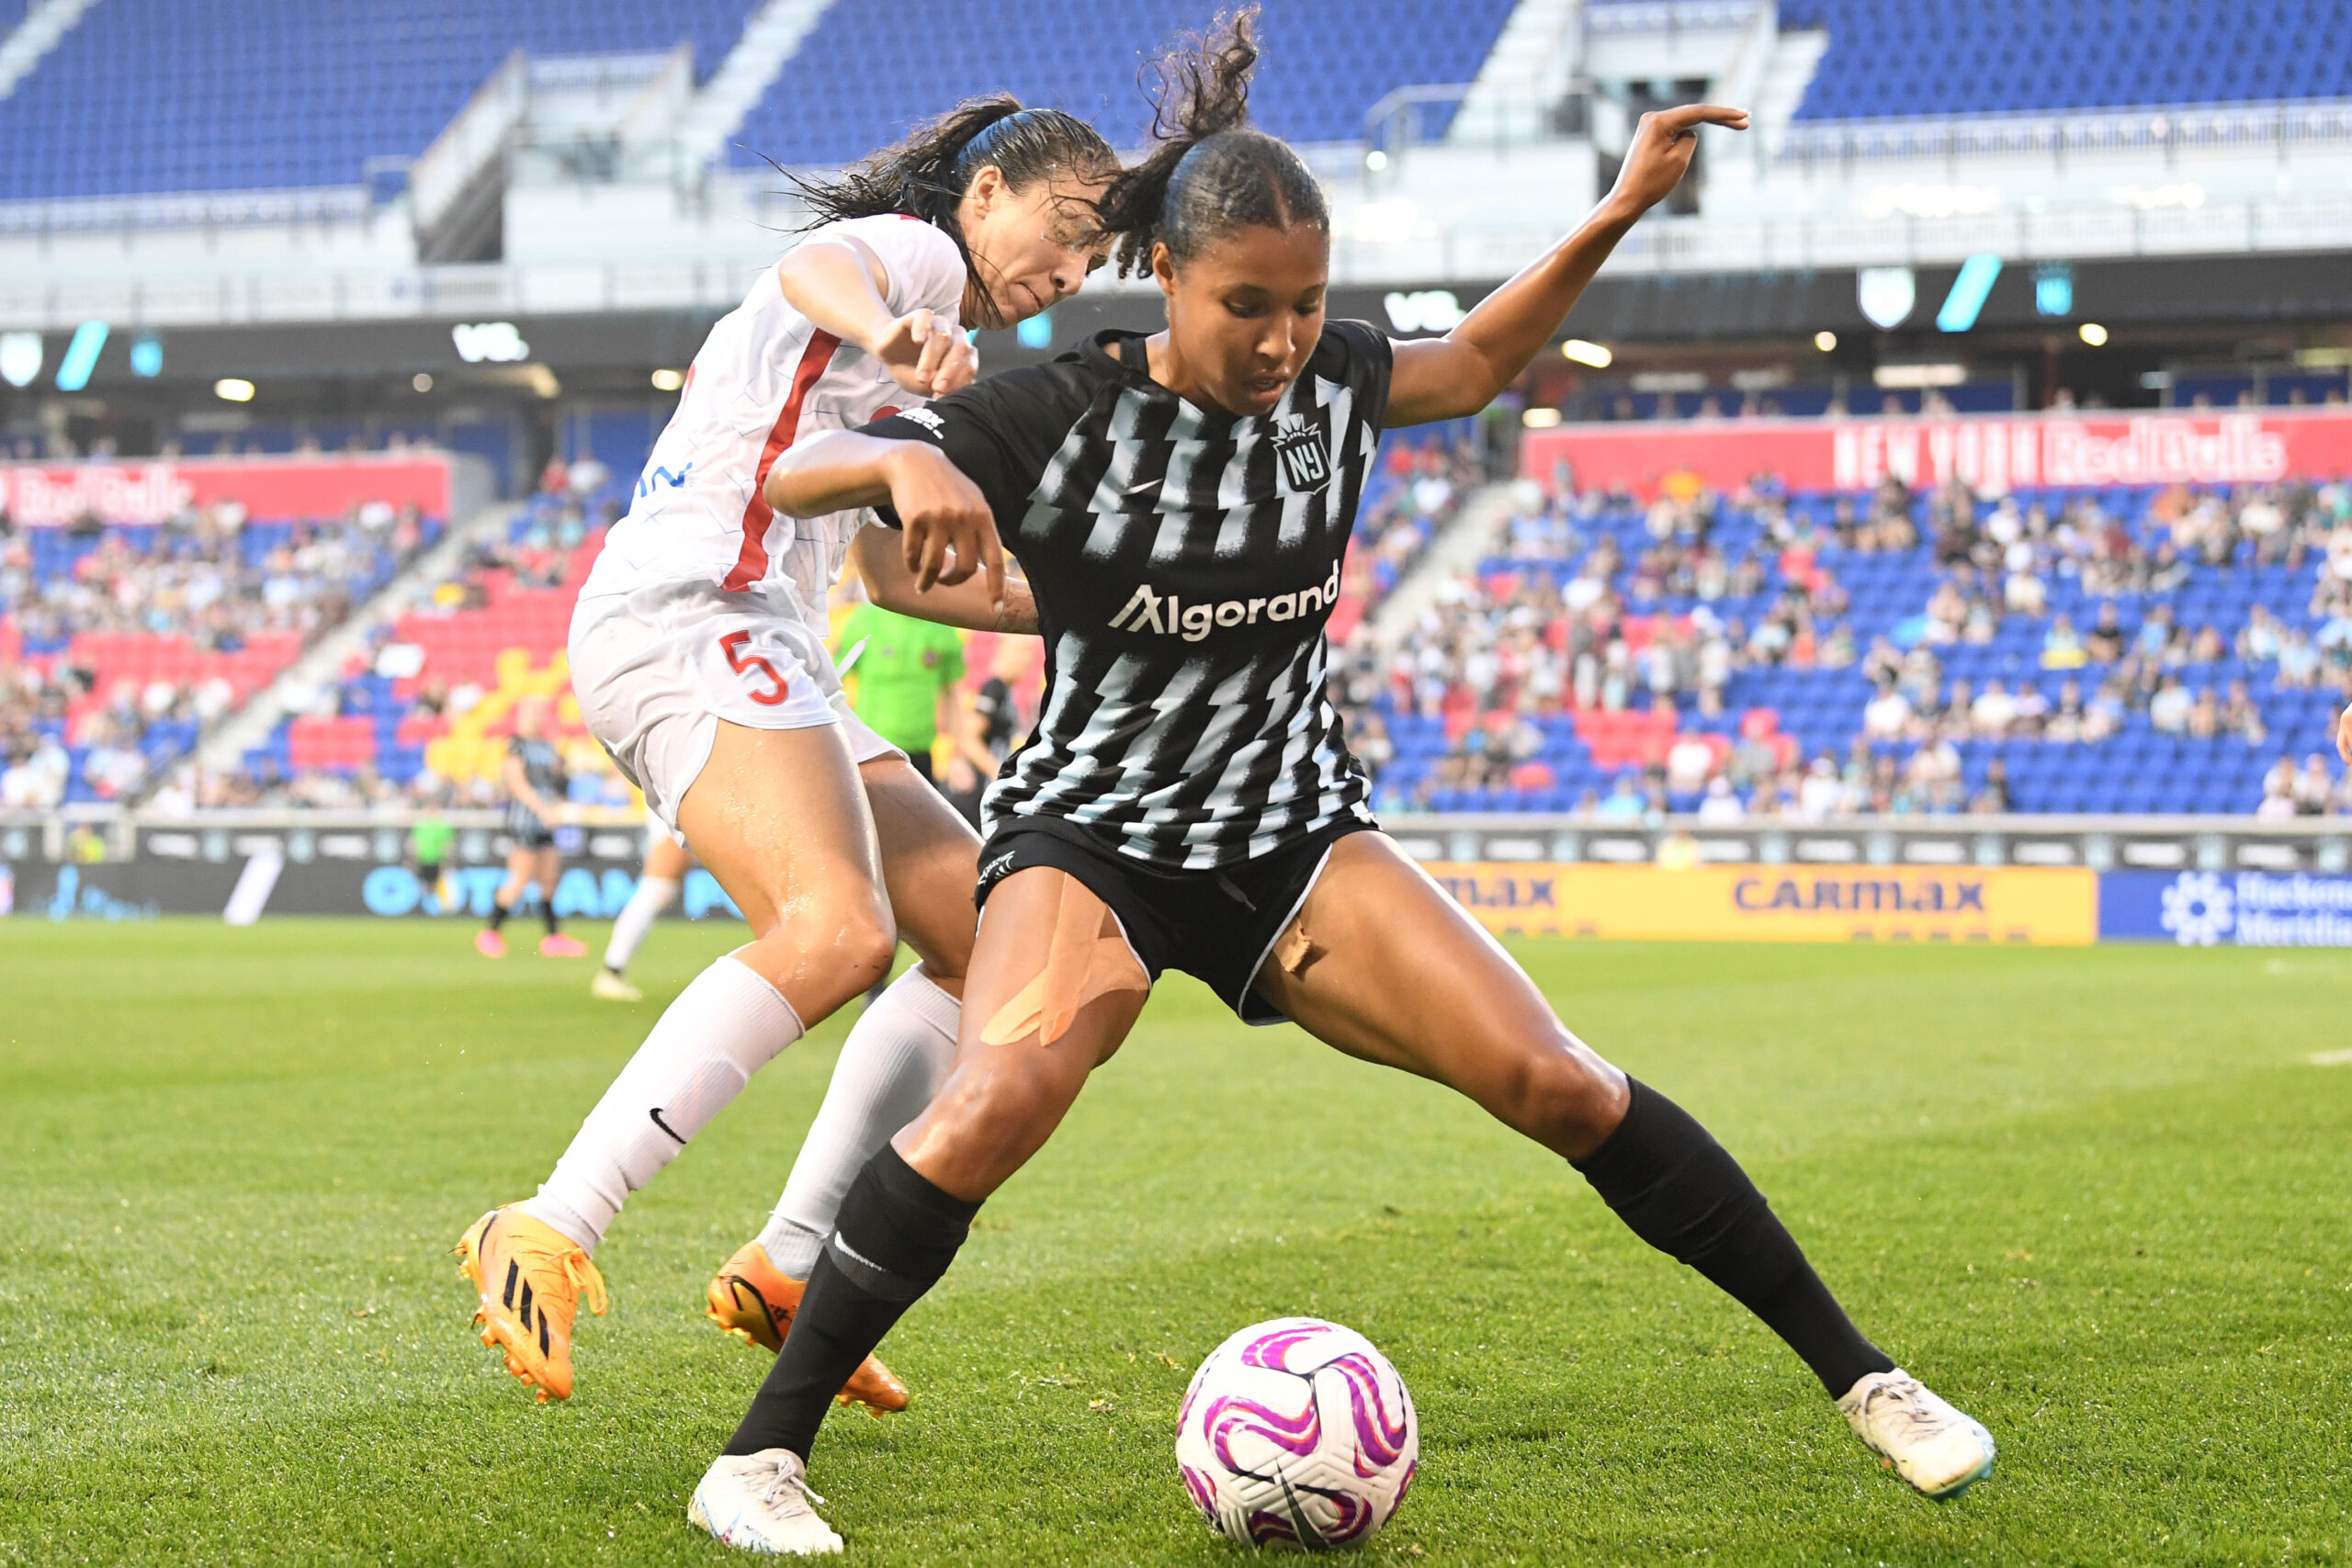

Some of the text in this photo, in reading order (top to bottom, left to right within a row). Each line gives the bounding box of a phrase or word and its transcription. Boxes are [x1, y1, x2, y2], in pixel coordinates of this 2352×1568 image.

[1286, 441, 1323, 485] NY
[1107, 558, 1340, 642] Algorand
[718, 629, 788, 706] 5
